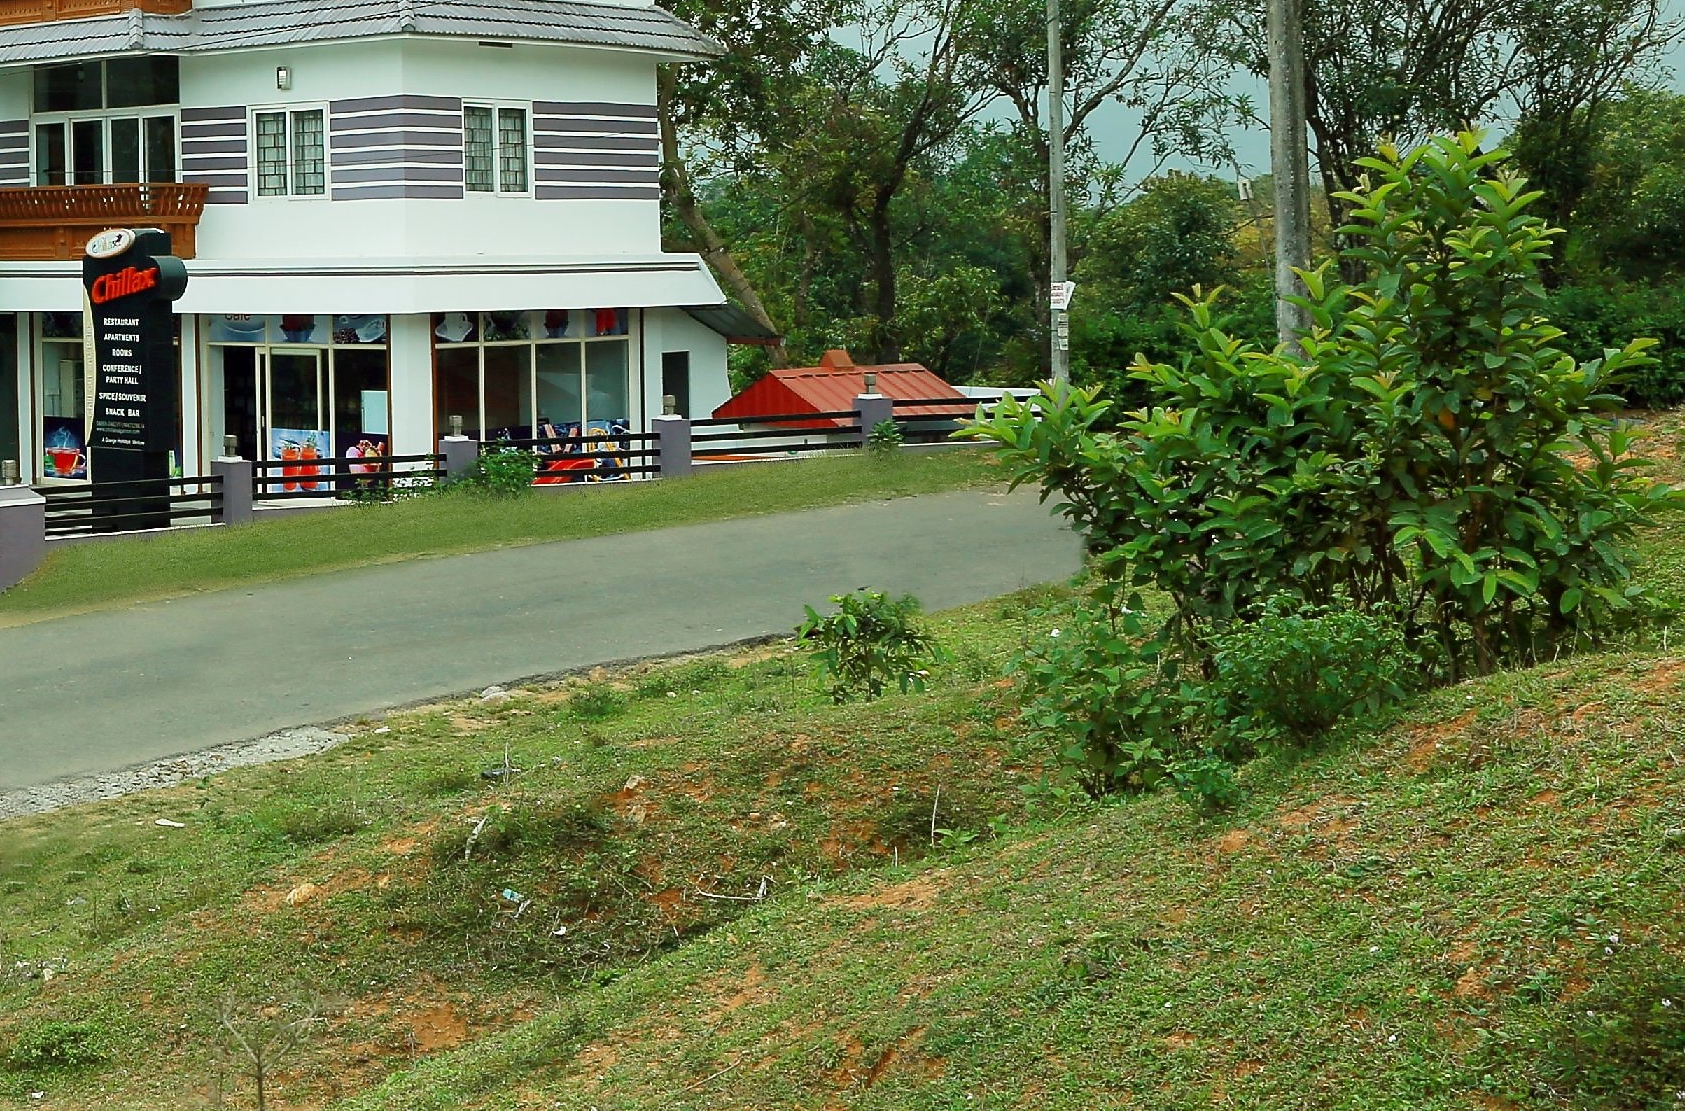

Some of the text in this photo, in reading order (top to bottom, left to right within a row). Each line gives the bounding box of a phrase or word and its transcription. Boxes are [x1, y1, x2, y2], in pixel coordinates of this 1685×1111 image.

[92, 266, 158, 304] Chillax
[103, 317, 140, 326] RESTAURANT
[103, 333, 140, 342] APARTMENTS
[111, 348, 133, 357] ROOMS
[105, 376, 139, 385] PARTY HALL
[105, 407, 140, 417] SNACK BAR
